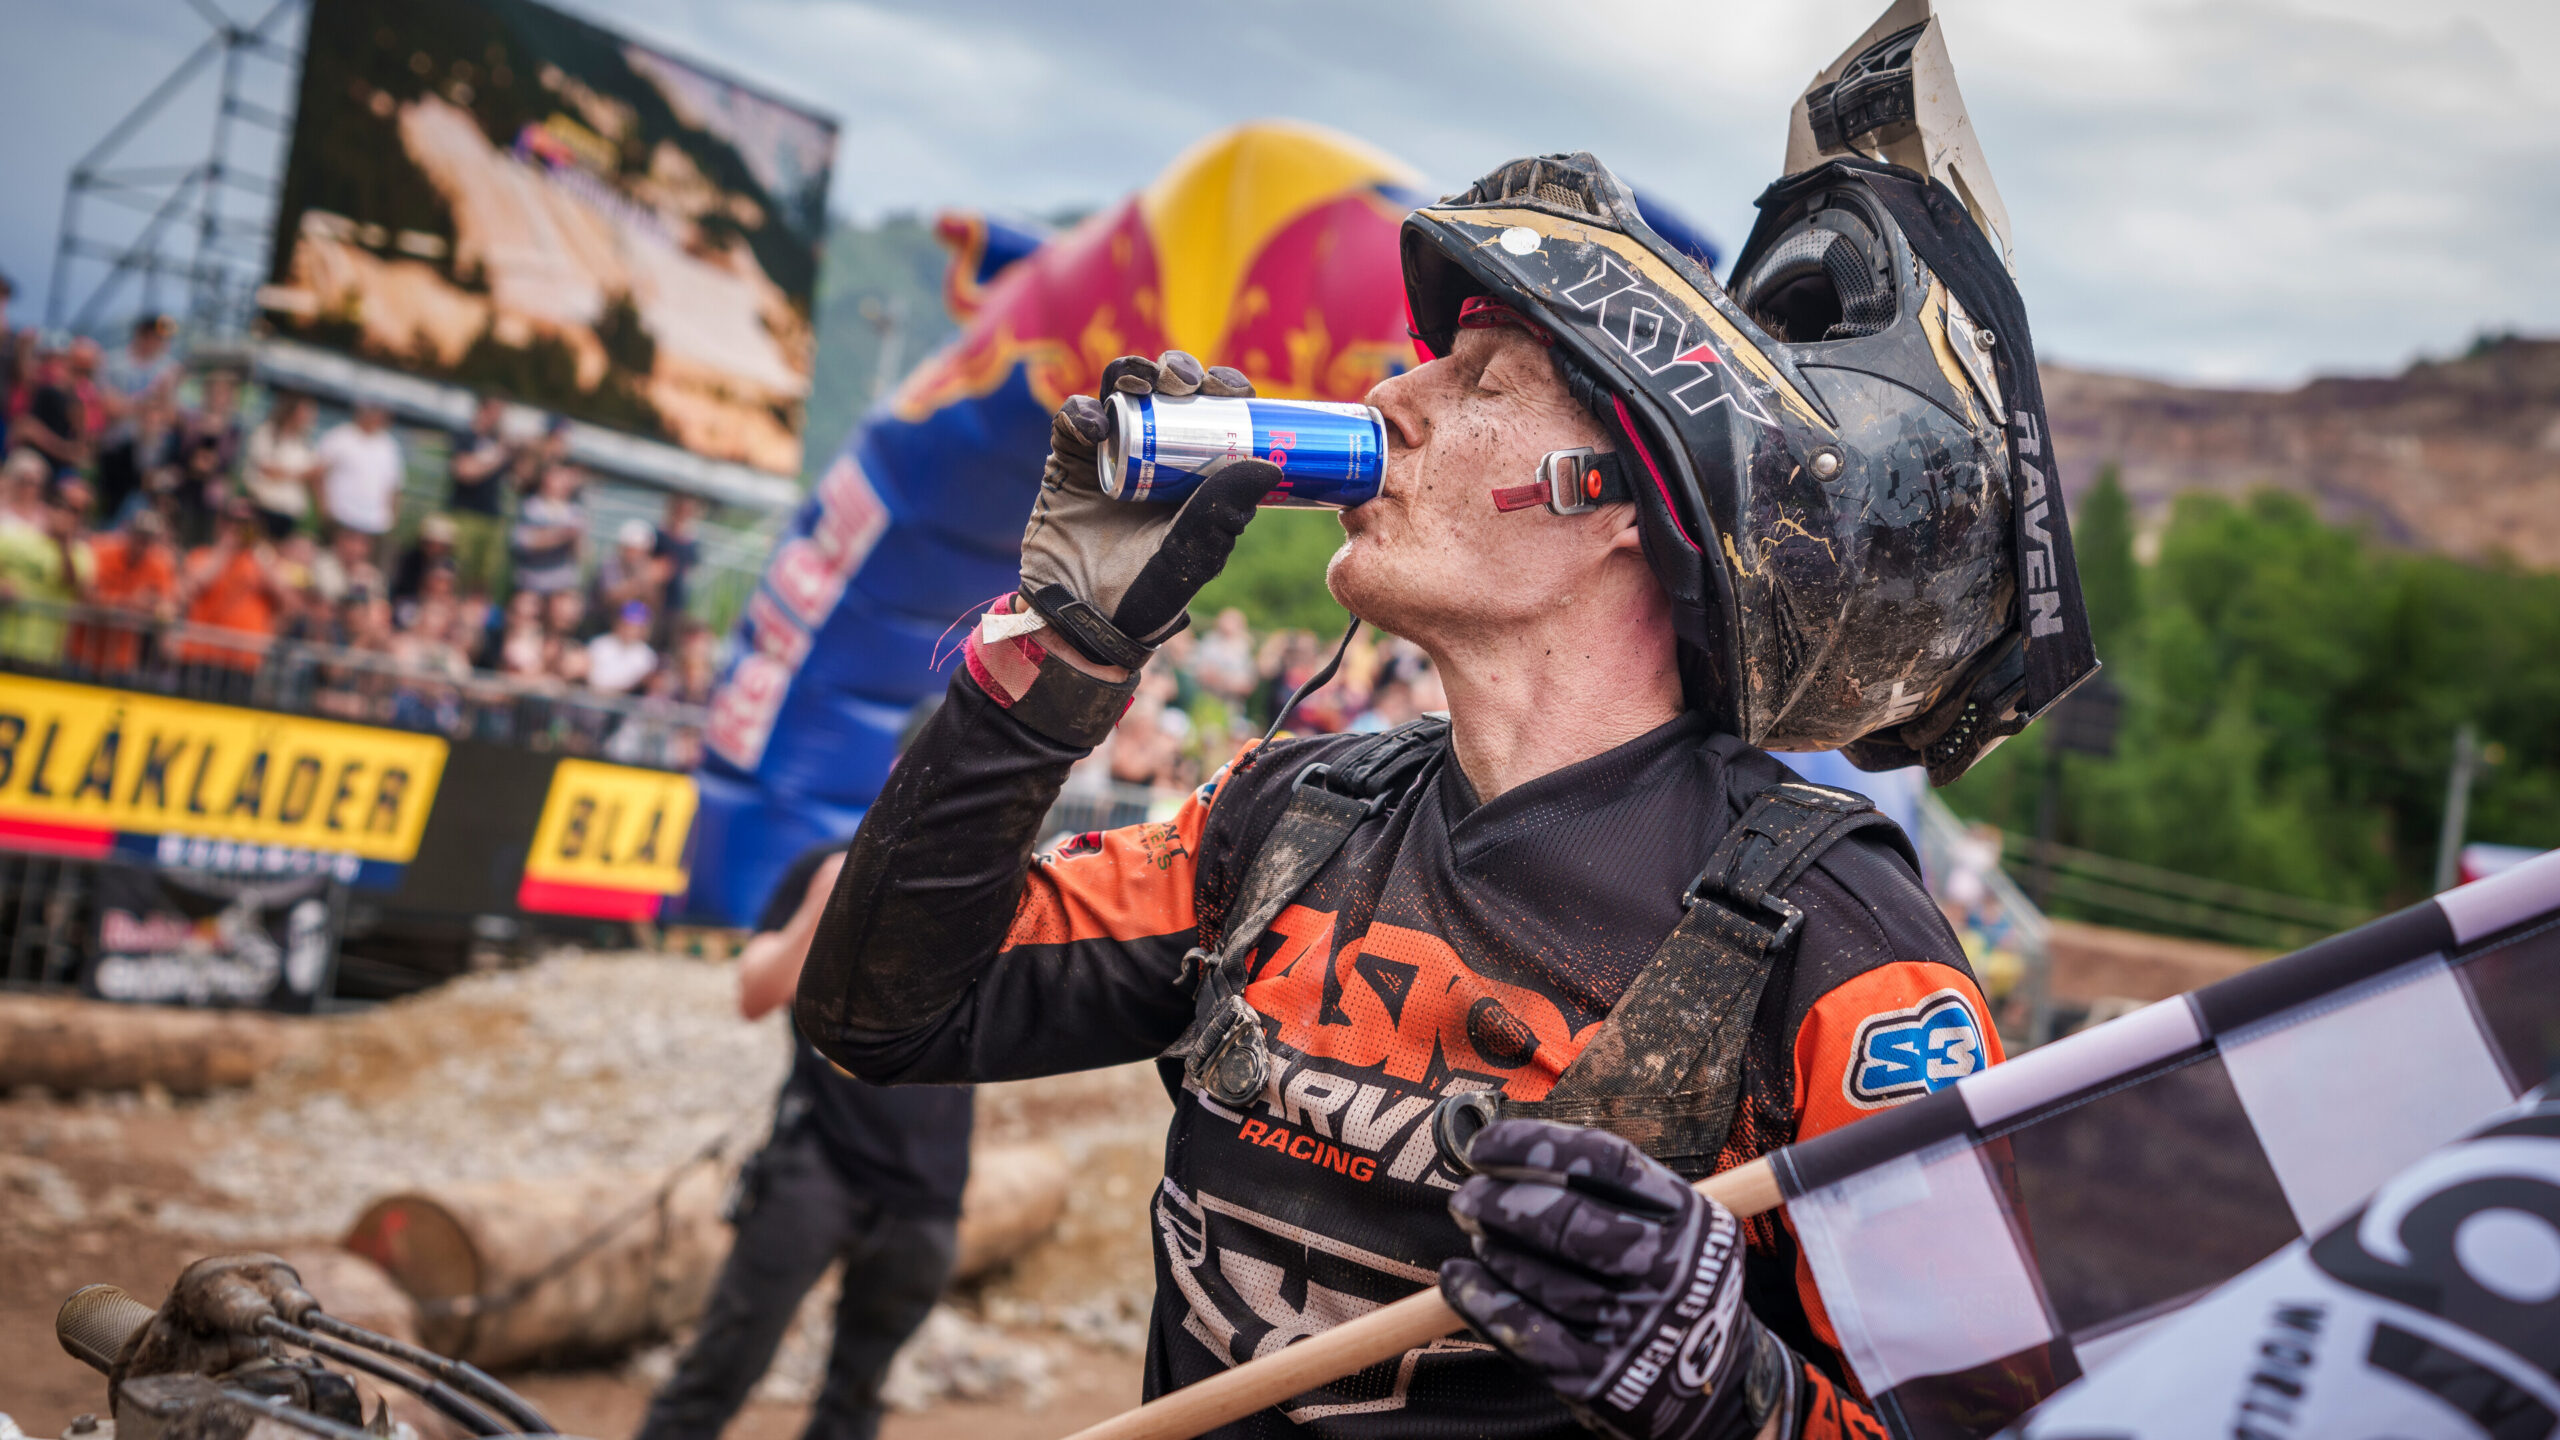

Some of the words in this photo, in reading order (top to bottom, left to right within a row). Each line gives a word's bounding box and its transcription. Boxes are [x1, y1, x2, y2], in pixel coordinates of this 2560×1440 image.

[1561, 254, 1783, 430] KYT
[2013, 410, 2065, 638] RAVEN
[1861, 1025, 1977, 1091] S3
[1238, 1117, 1377, 1183] RACING
